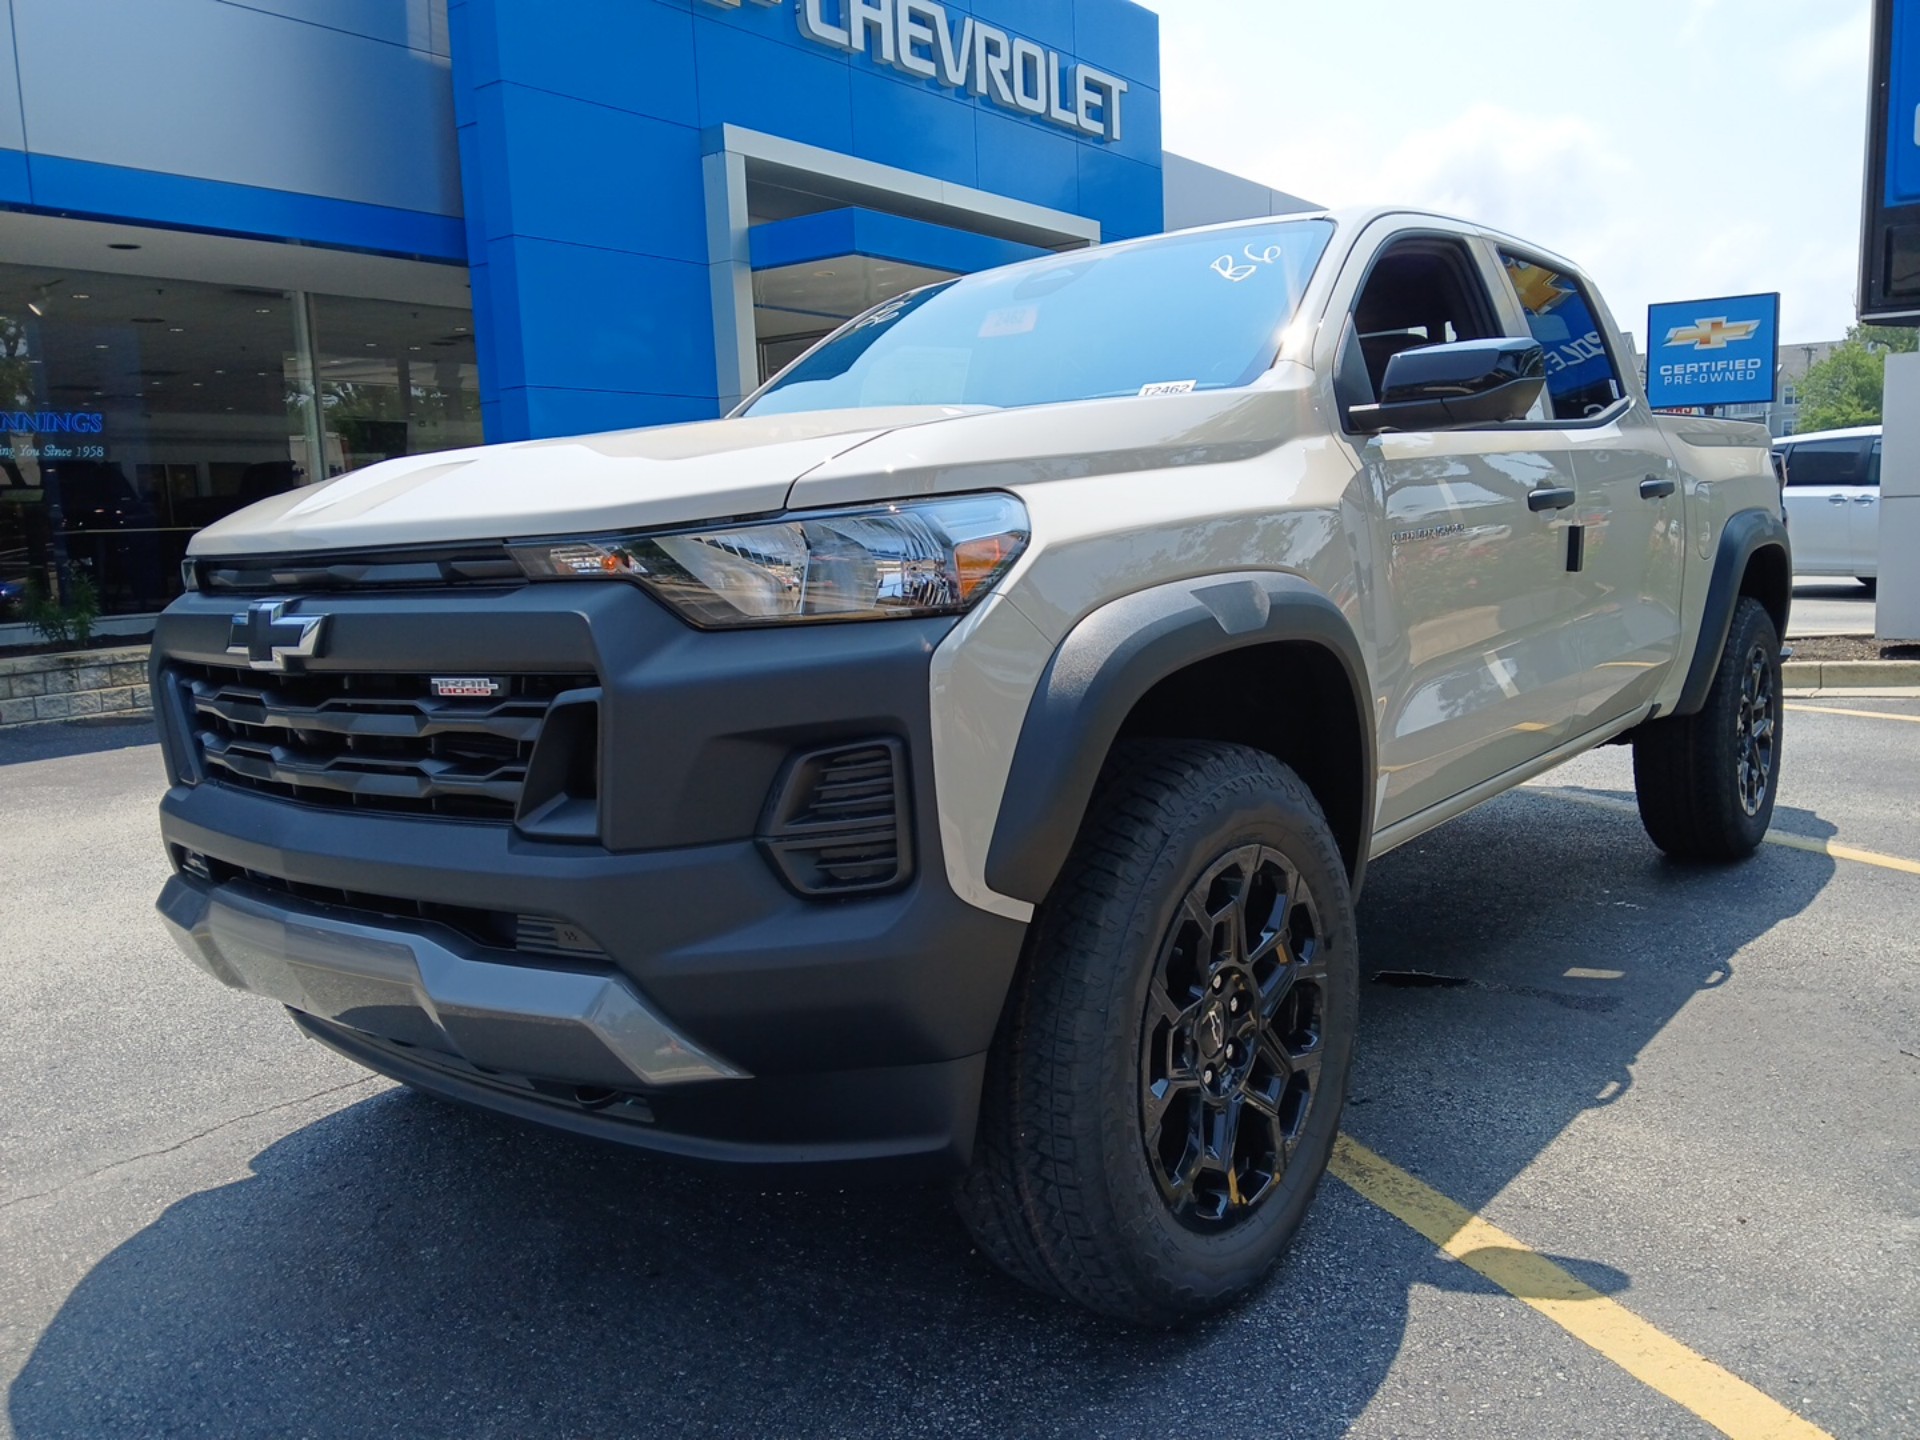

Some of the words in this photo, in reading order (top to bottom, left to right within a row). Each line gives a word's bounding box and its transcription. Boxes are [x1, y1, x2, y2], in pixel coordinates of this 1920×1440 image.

[802, 0, 1128, 141] CHEVROLET
[1660, 358, 1761, 375] CERTIFIED
[1664, 370, 1756, 385] PRE-OWNED
[1143, 384, 1190, 396] T2462
[19, 444, 40, 457] You
[43, 443, 72, 457] Since
[76, 445, 104, 458] 1958
[431, 678, 498, 689] TRAIL
[439, 687, 491, 696] BOSS
